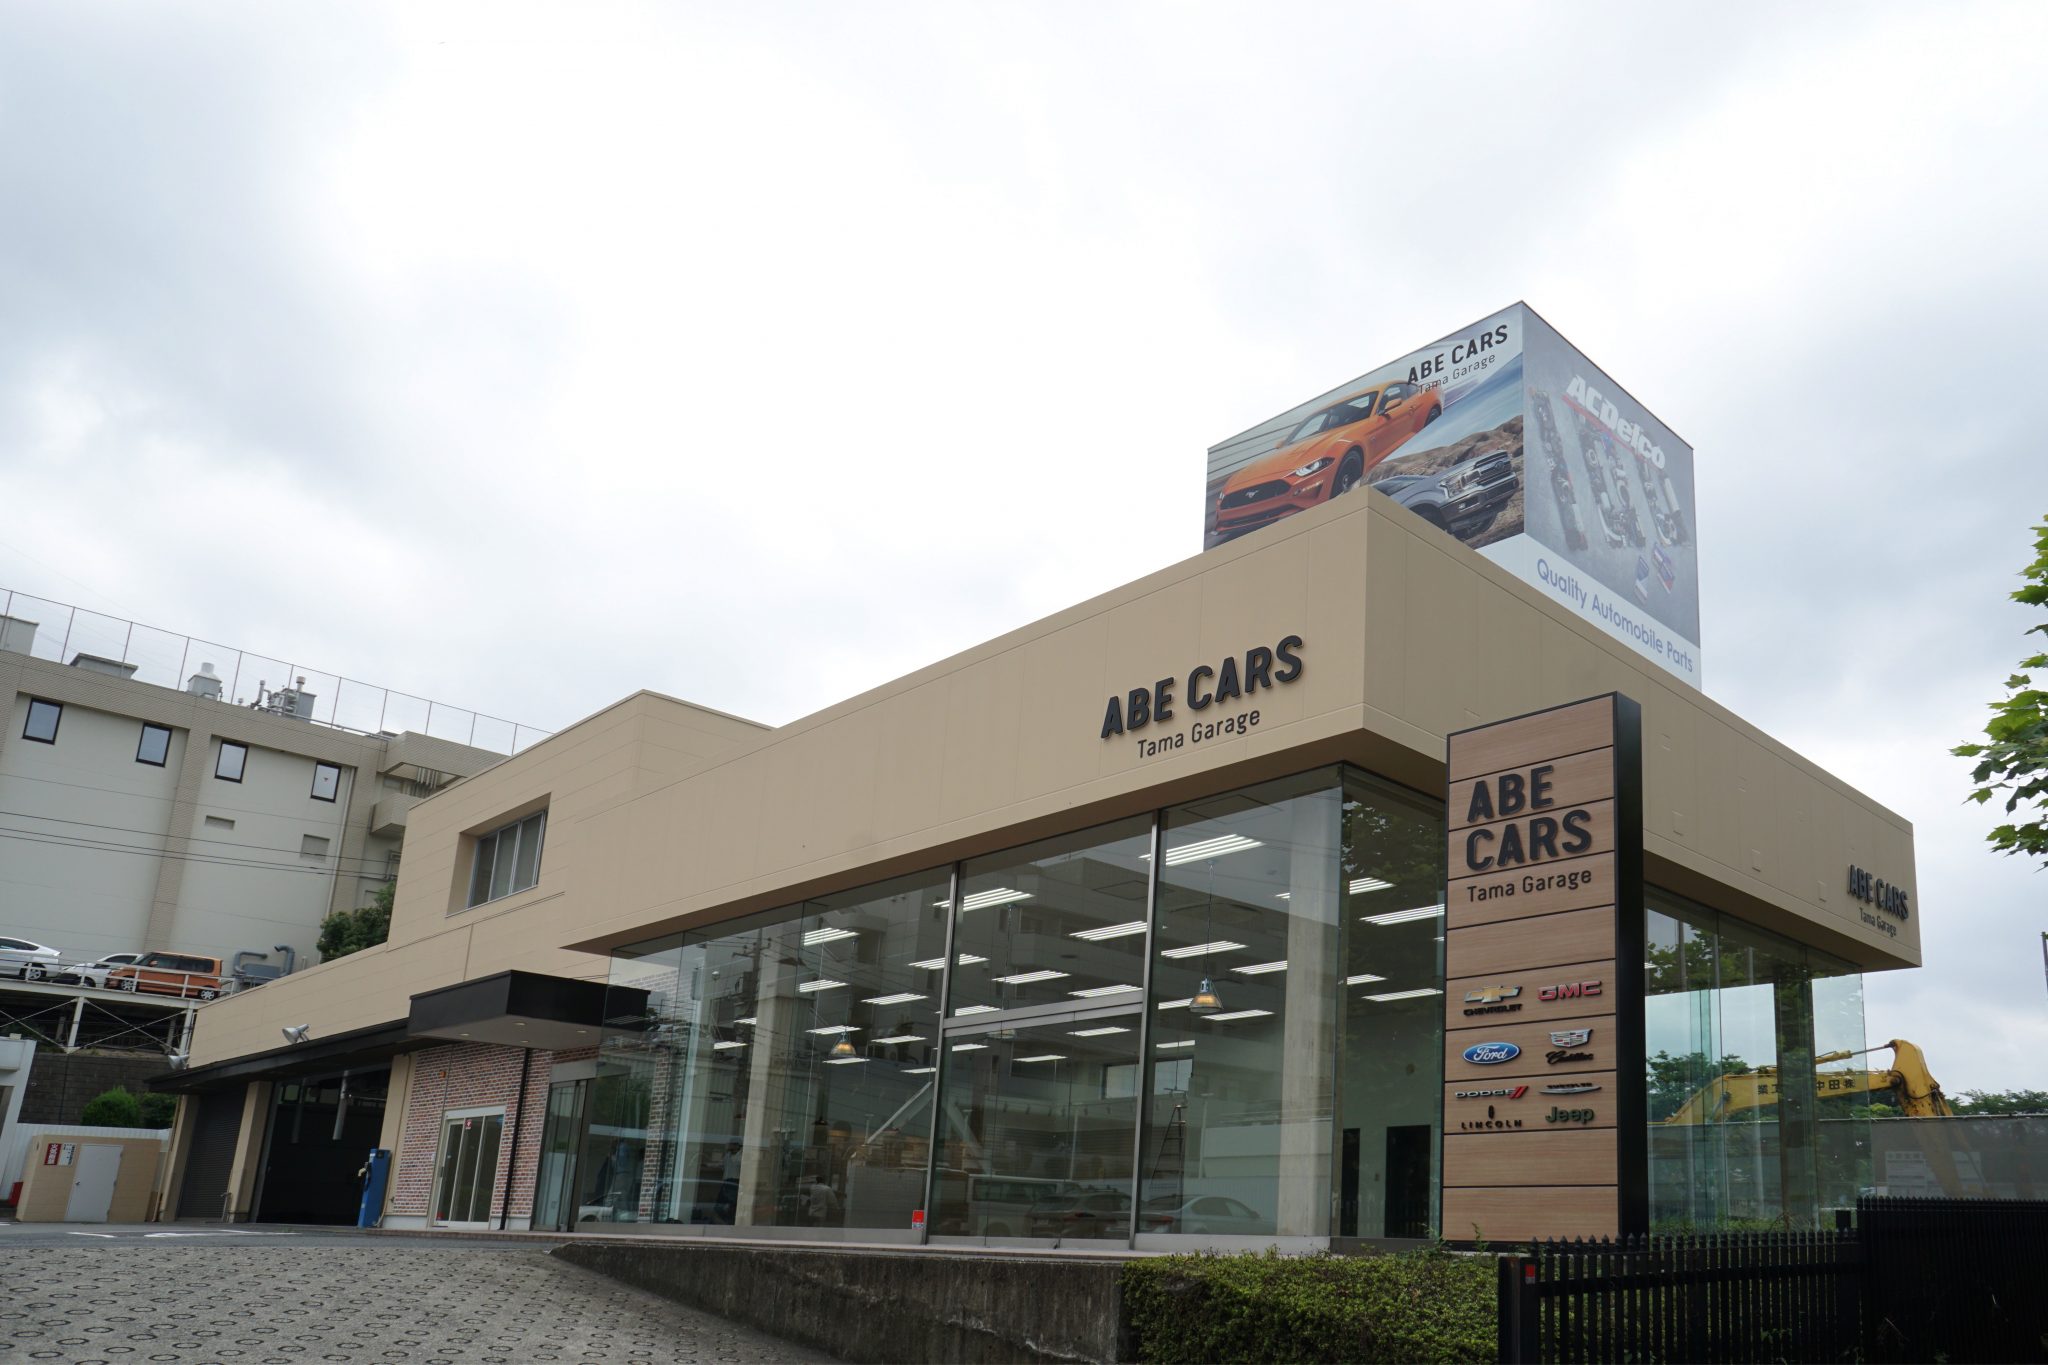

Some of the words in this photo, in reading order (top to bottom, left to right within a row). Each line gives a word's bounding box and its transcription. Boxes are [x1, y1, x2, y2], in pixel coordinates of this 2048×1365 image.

[1407, 352, 1445, 386] ABE
[1451, 324, 1508, 364] CARS
[1419, 375, 1449, 394] Tama
[1452, 354, 1496, 380] Garage
[1566, 374, 1666, 469] ACDelco
[1537, 558, 1588, 609] Quality
[1591, 593, 1664, 654] Automobile
[1666, 640, 1694, 673] Parts
[1100, 676, 1175, 739] ABE
[1186, 634, 1304, 711] CARS
[1137, 732, 1185, 759] Tama
[1191, 709, 1261, 742] Garage
[1466, 764, 1555, 824] ABE
[1465, 808, 1593, 872] CARS
[1466, 882, 1516, 903] Tama
[1522, 869, 1592, 893] Garage
[1847, 863, 1874, 905] ABE
[1875, 878, 1909, 921] CARS
[1537, 980, 1602, 1001] GMC
[1473, 1045, 1508, 1061] Ford
[1455, 1087, 1517, 1099] DODGE
[1545, 1106, 1594, 1124] Jeep
[1461, 1119, 1523, 1130] LINCOLN
